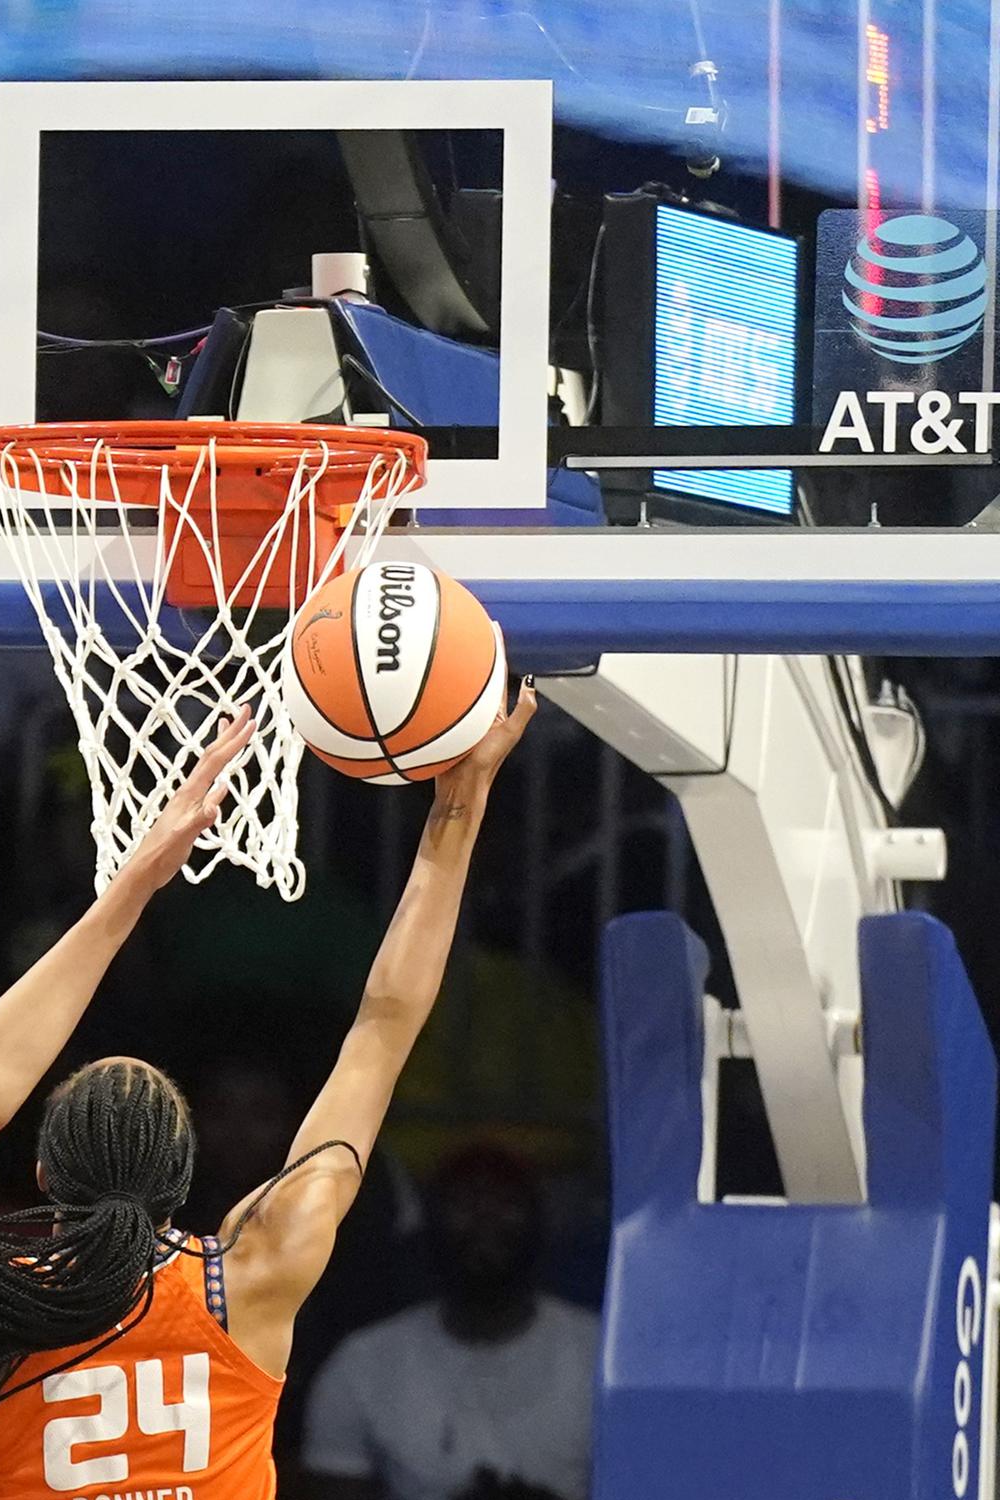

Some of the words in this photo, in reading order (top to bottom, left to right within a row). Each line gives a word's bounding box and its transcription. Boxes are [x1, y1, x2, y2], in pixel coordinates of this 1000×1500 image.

[818, 390, 1000, 454] AT&T
[376, 565, 415, 674] Wilson
[42, 1352, 211, 1491] 24
